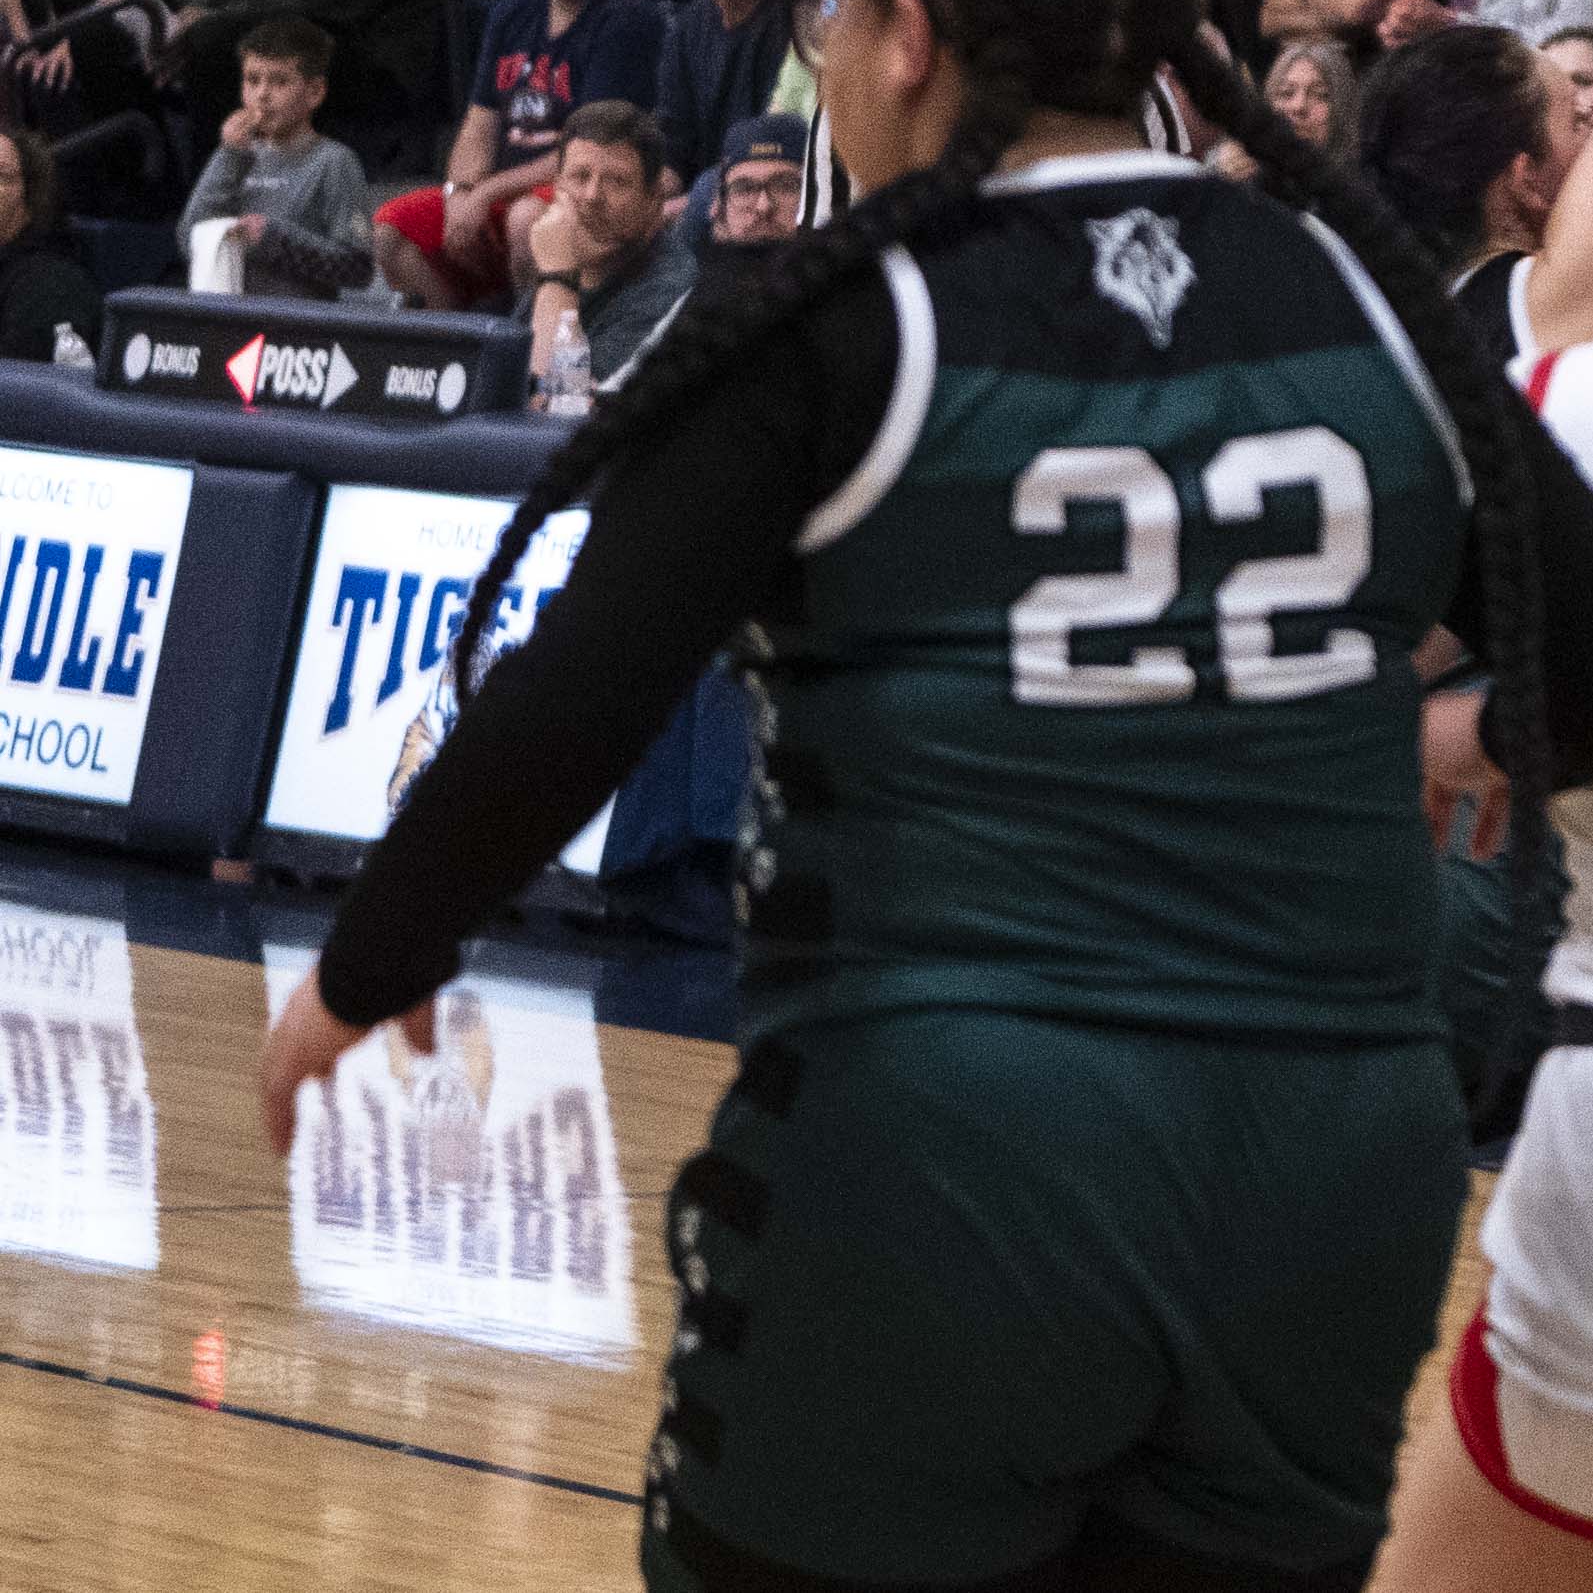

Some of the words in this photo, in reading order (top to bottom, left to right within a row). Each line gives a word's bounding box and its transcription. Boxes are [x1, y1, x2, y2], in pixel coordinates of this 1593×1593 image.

[151, 343, 200, 377] BONUS
[256, 343, 329, 398] POSS
[384, 365, 437, 400] BONUS
[87, 481, 113, 510] TO
[417, 518, 489, 552] HOME
[1008, 424, 1378, 706] 22
